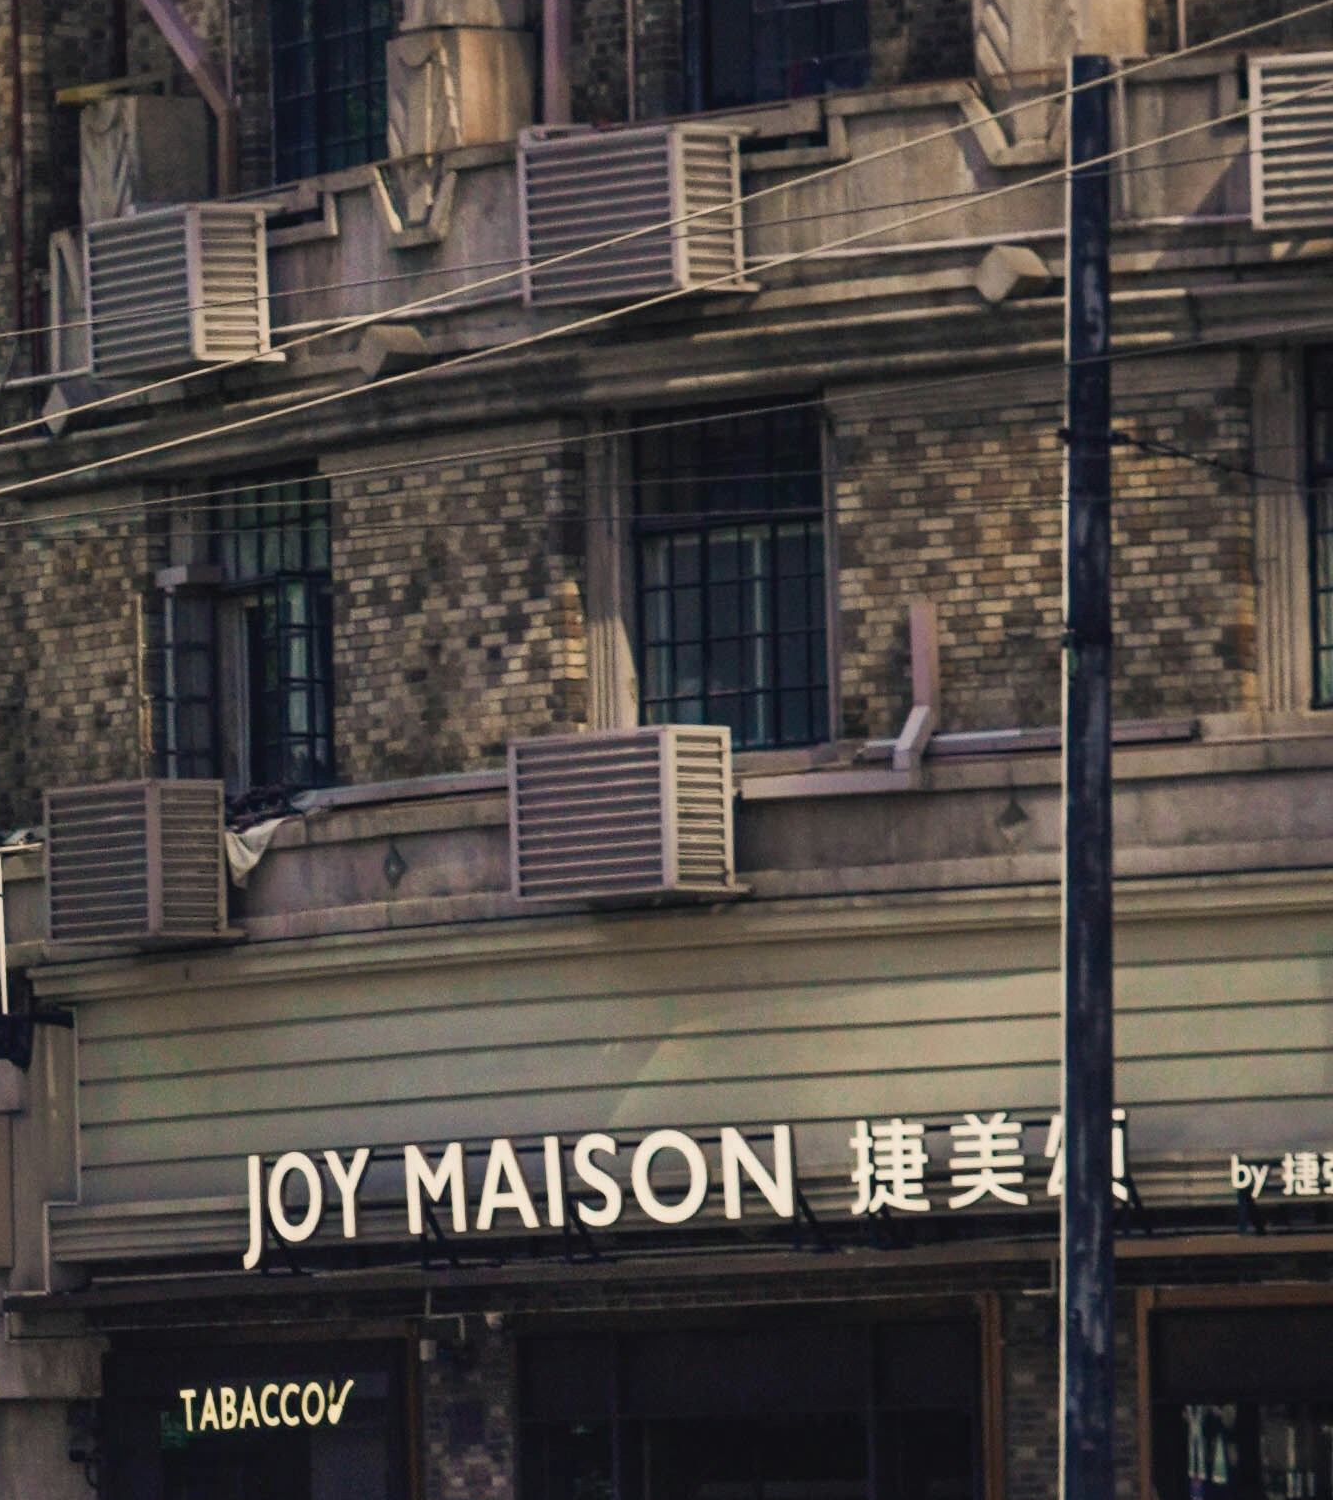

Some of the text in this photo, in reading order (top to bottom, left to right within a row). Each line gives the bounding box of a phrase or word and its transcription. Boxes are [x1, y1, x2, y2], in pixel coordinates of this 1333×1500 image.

[243, 1124, 795, 1270] JOY MAISON
[1231, 1153, 1269, 1199] by
[179, 1381, 326, 1432] TABACCO
